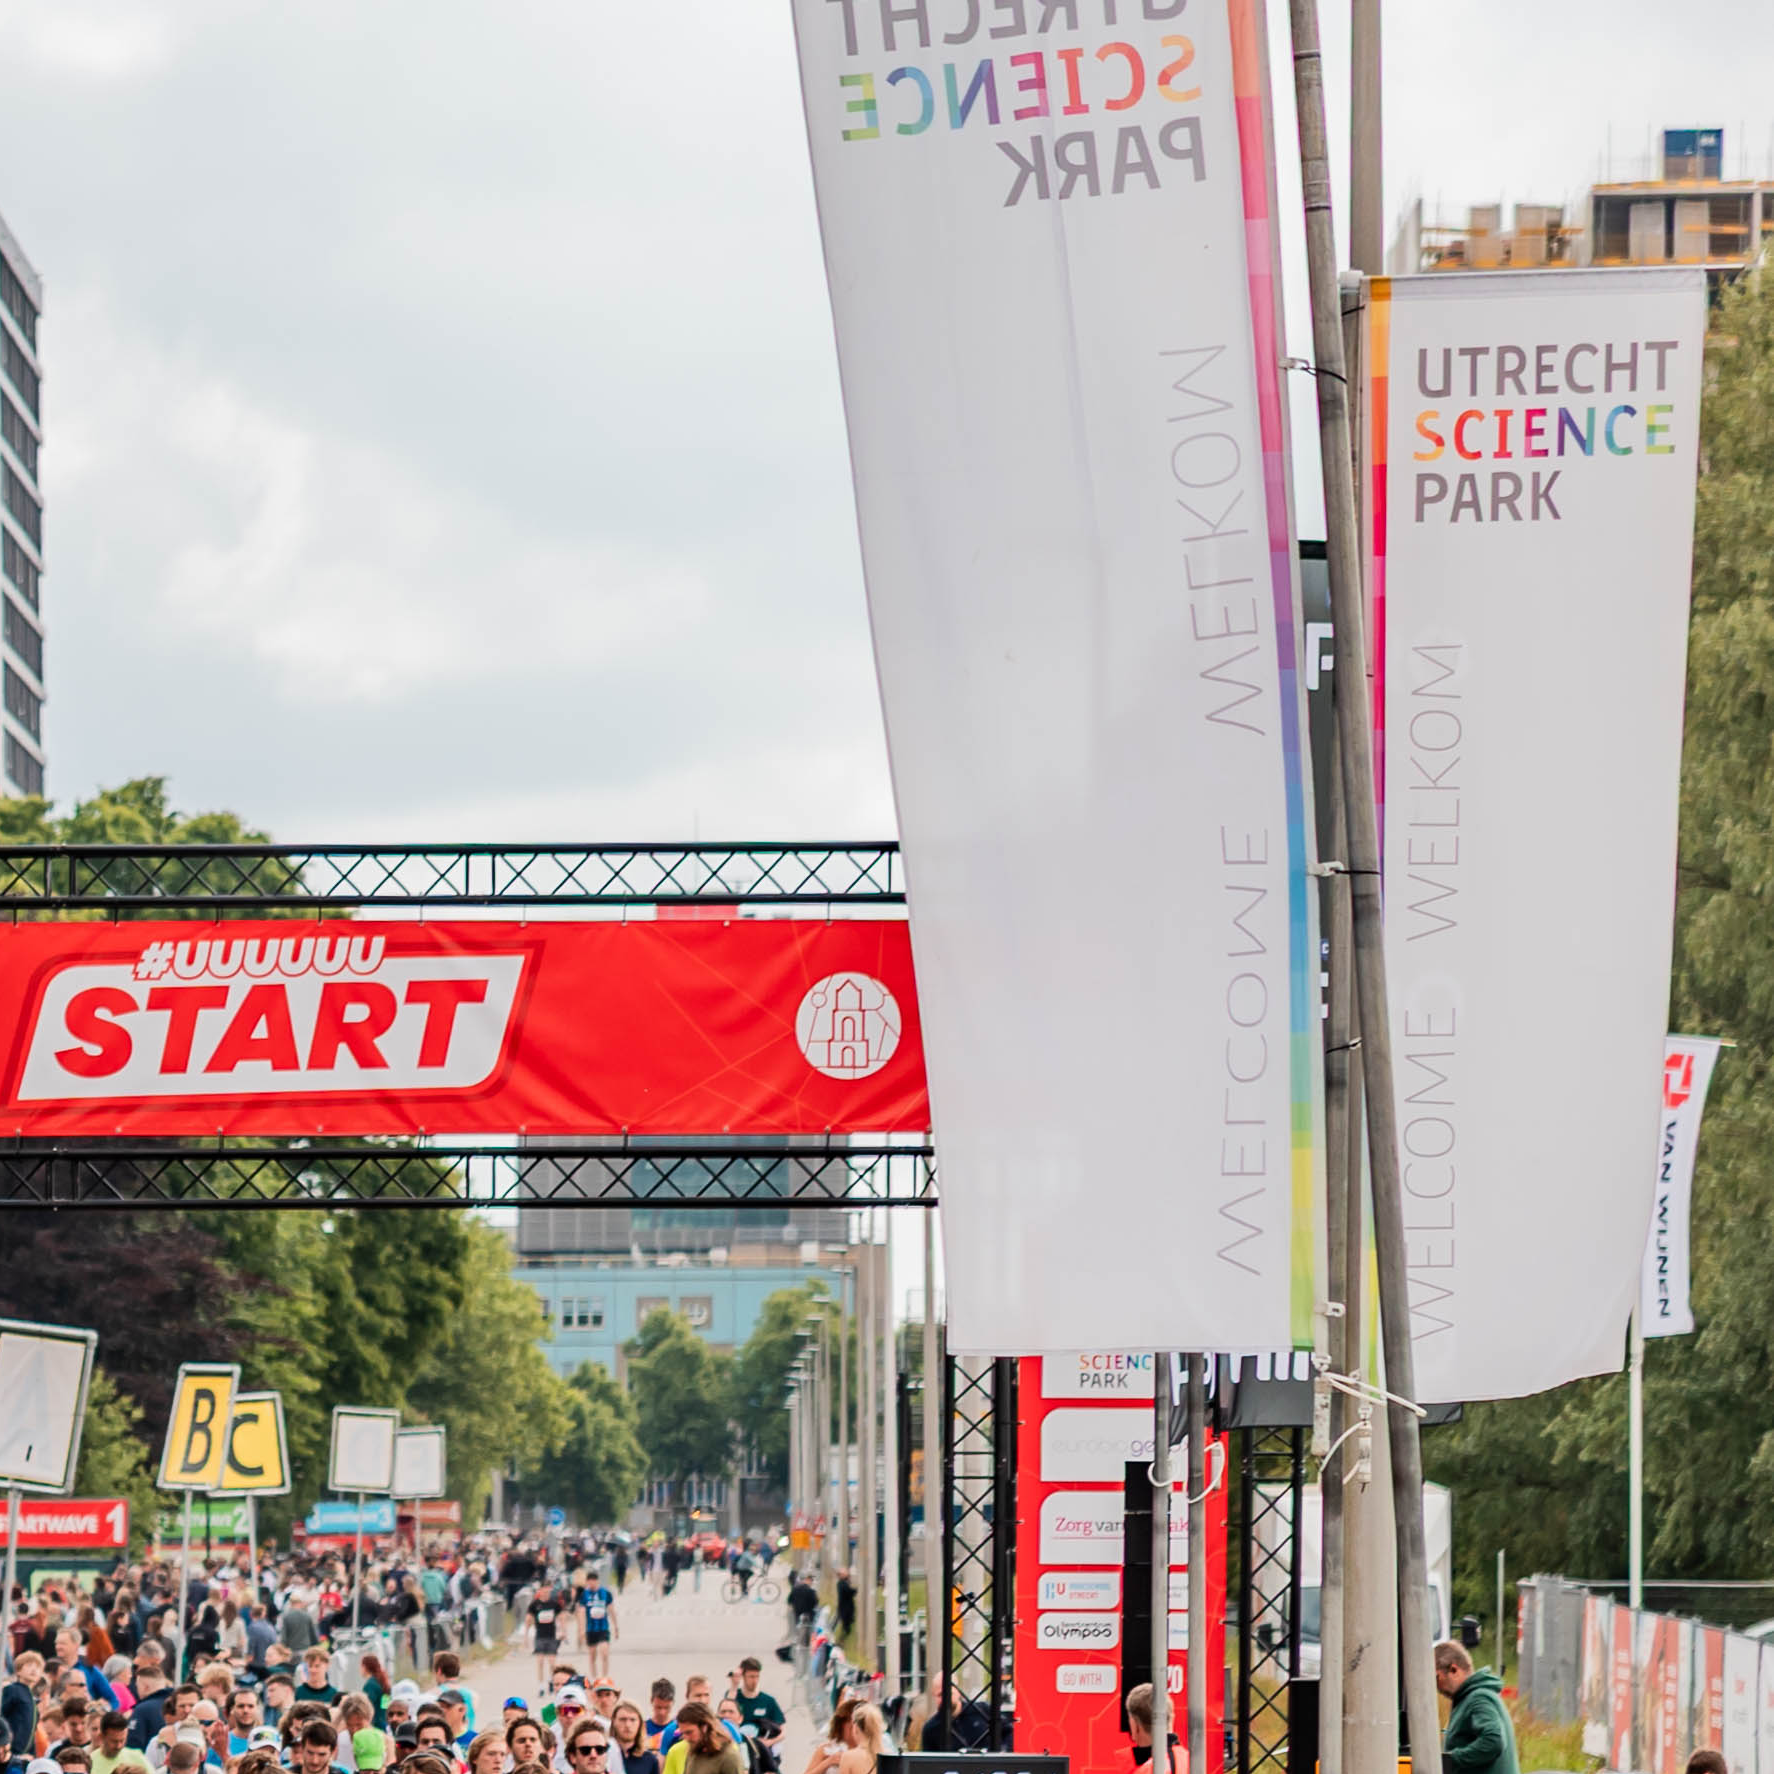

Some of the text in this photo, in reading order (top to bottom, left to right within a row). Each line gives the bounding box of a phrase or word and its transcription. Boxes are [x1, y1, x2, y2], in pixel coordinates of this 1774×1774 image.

[1417, 341, 1680, 399] UTRECHT
[1413, 403, 1677, 462] SCIENCE
[1415, 471, 1563, 524] PARK
[1407, 643, 1464, 943] WELKOM
[54, 980, 489, 1078] START
[1403, 1005, 1457, 1341] WELCOME
[1079, 1373, 1128, 1389] PARK
[180, 1387, 216, 1474] B
[228, 1412, 265, 1476] C
[106, 1503, 125, 1544] 1
[1055, 1516, 1093, 1536] Zorg
[1079, 1673, 1102, 1686] WITH
